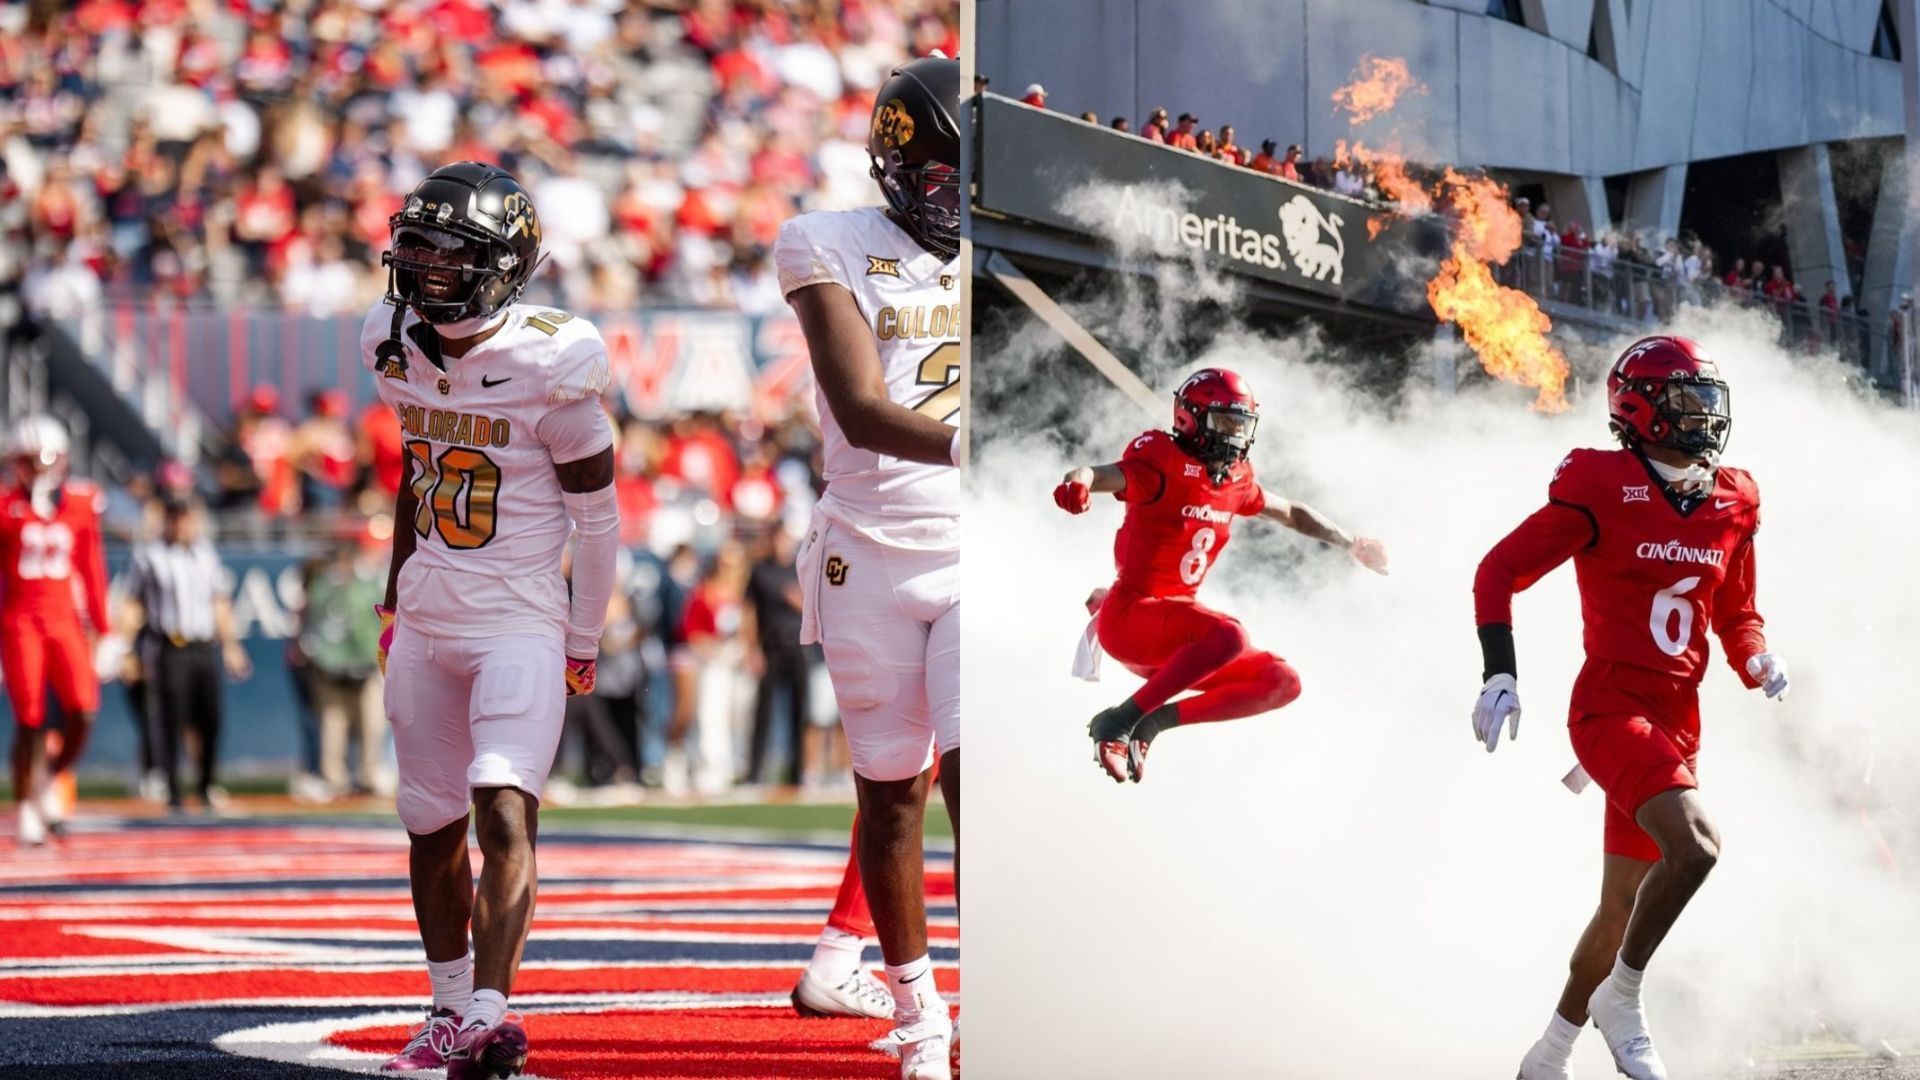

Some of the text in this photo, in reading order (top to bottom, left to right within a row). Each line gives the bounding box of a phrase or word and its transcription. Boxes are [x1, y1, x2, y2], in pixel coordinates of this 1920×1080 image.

[404, 439, 502, 549] 10
[1180, 527, 1216, 585] 8
[1636, 540, 1724, 568] CINCINNATI
[1650, 576, 1701, 657] 6
